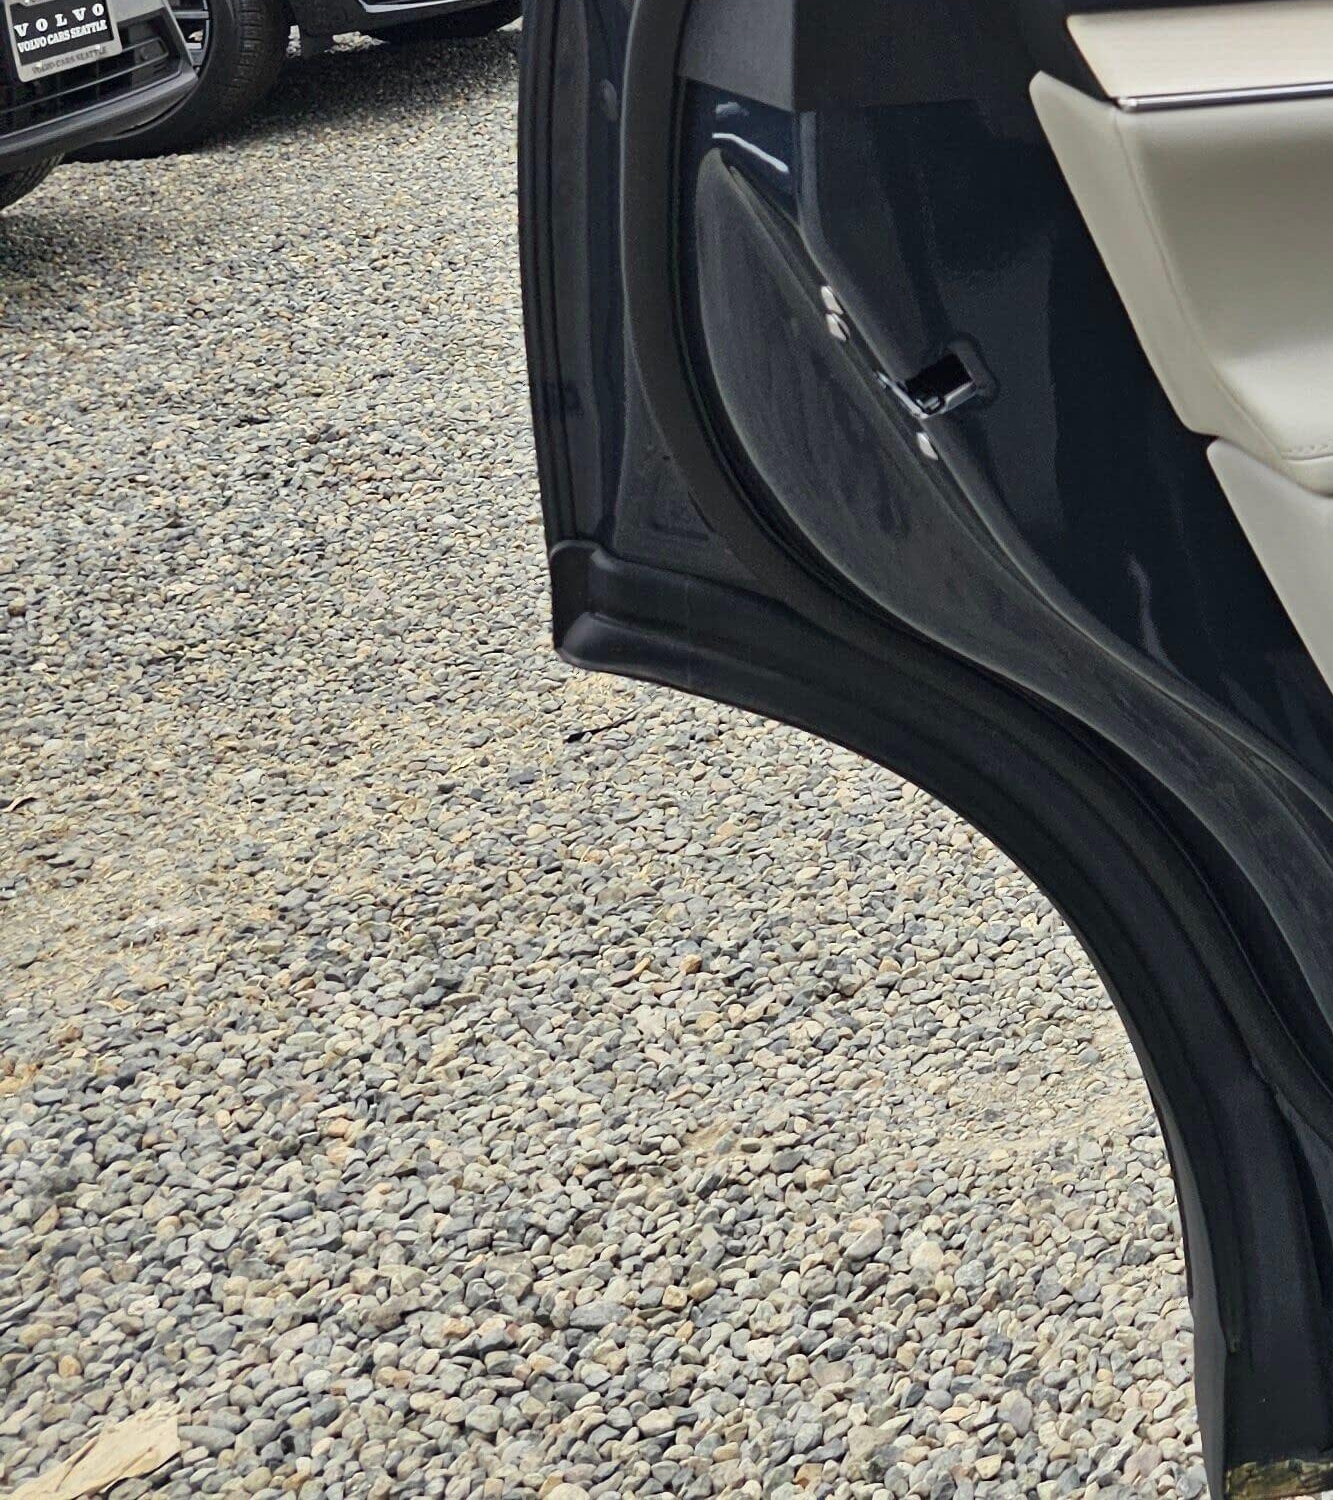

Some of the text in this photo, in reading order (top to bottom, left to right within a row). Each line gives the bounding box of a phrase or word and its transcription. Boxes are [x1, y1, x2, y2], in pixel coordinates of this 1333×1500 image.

[13, 3, 105, 37] VOLVO
[17, 19, 108, 53] VOLVO CARS SEATTLE
[75, 45, 108, 62] SEATTLE
